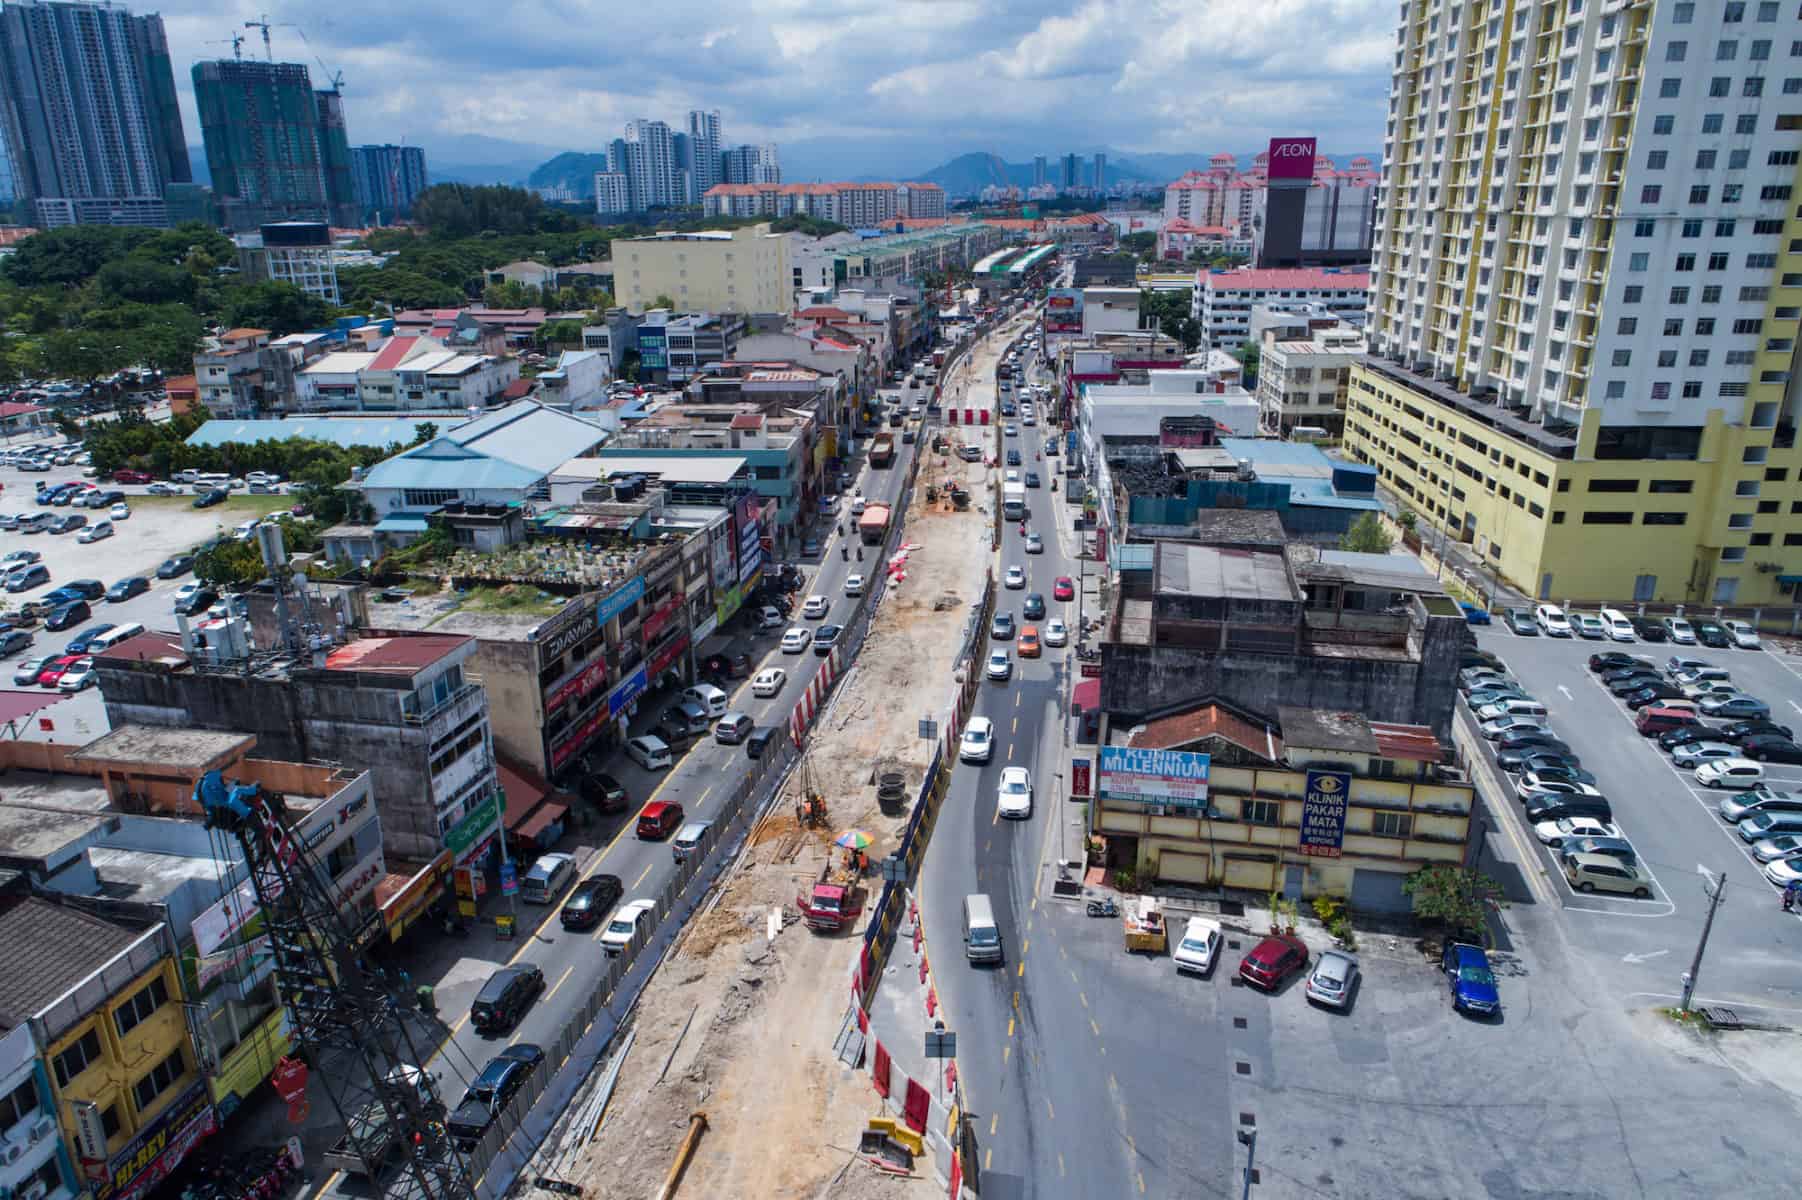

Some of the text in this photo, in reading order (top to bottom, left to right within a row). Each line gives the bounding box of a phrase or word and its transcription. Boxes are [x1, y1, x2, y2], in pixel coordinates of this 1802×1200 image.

[1126, 748, 1183, 763] KLINIK
[1103, 757, 1206, 777] MILLENNIUM
[1307, 792, 1344, 805] KLINIK
[1306, 804, 1344, 817] PAKAR
[1308, 815, 1338, 829] MATA
